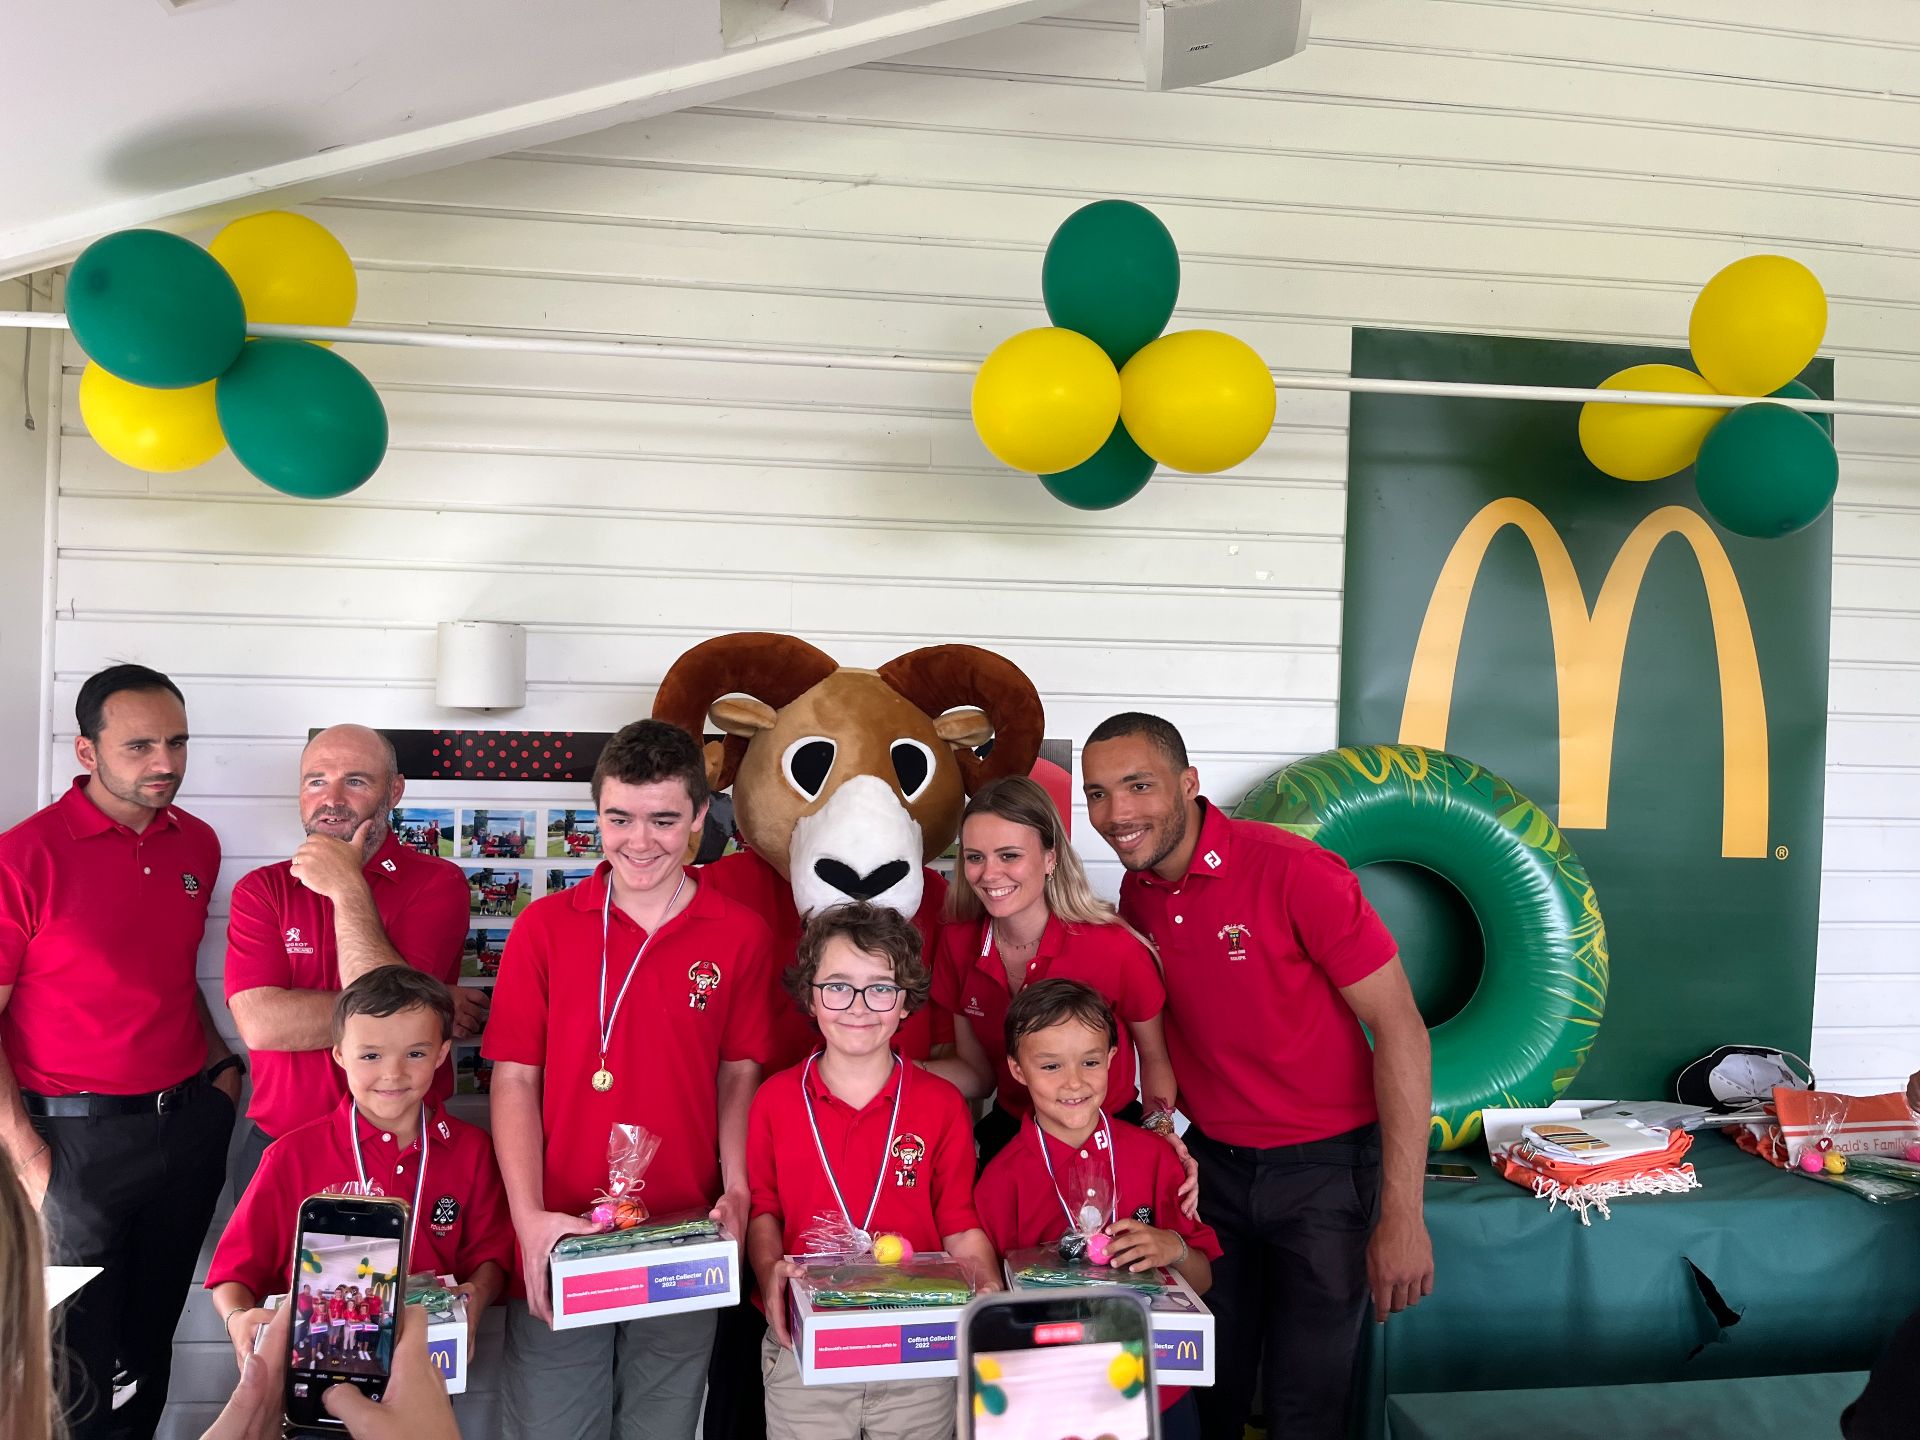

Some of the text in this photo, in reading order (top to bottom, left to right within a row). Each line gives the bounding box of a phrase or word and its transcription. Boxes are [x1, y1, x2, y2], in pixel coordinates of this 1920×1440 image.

[1874, 1138, 1908, 1150] Family
[654, 1275, 675, 1284] Coffret
[676, 1272, 703, 1281] Collector
[907, 1334, 957, 1344] Coffret Collector
